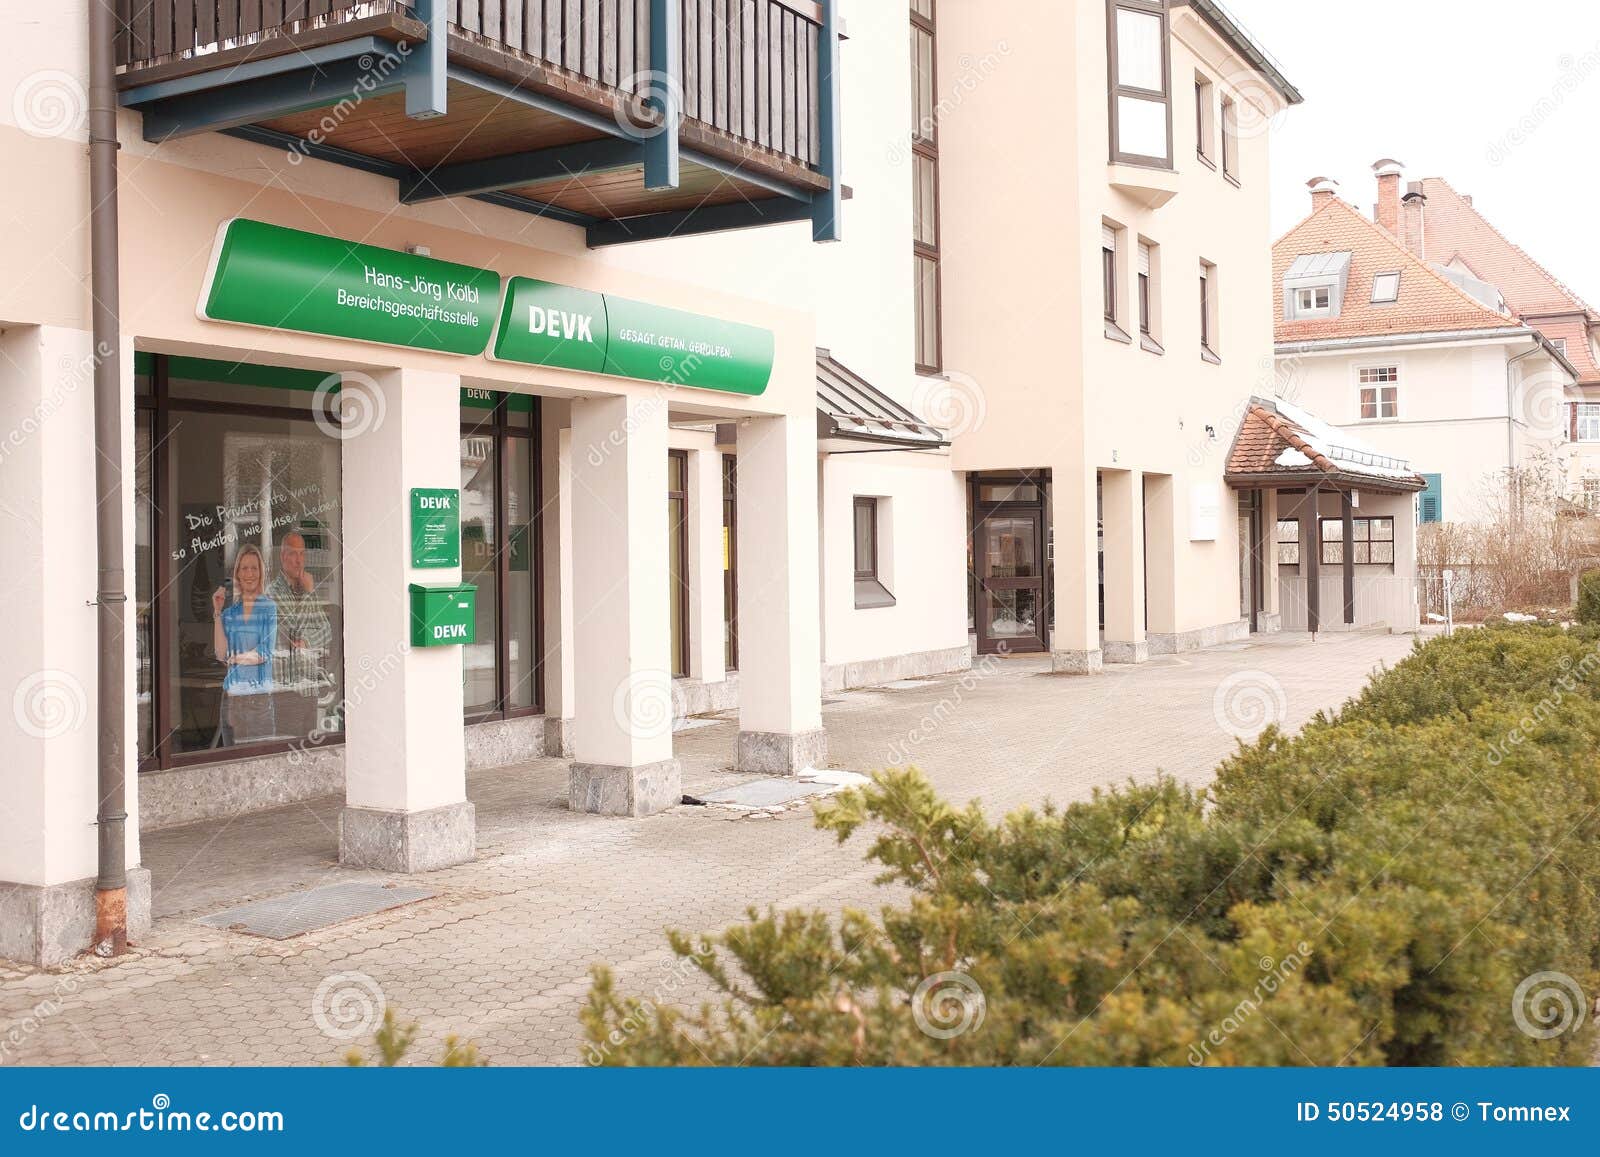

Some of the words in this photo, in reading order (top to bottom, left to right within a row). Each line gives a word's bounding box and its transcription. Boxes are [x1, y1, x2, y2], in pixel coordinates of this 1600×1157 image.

[364, 265, 442, 301] Hans-Jörg
[447, 281, 479, 304] Kölbl
[337, 288, 479, 327] Bereichsgeschäftsstelle
[528, 305, 593, 343] DEVK
[467, 388, 491, 400] DEVK
[420, 496, 451, 509] DEVK
[185, 513, 213, 531] Die
[172, 547, 186, 561] so
[191, 528, 239, 555] flexibel
[244, 522, 264, 538] wie
[433, 623, 467, 639] DEVK
